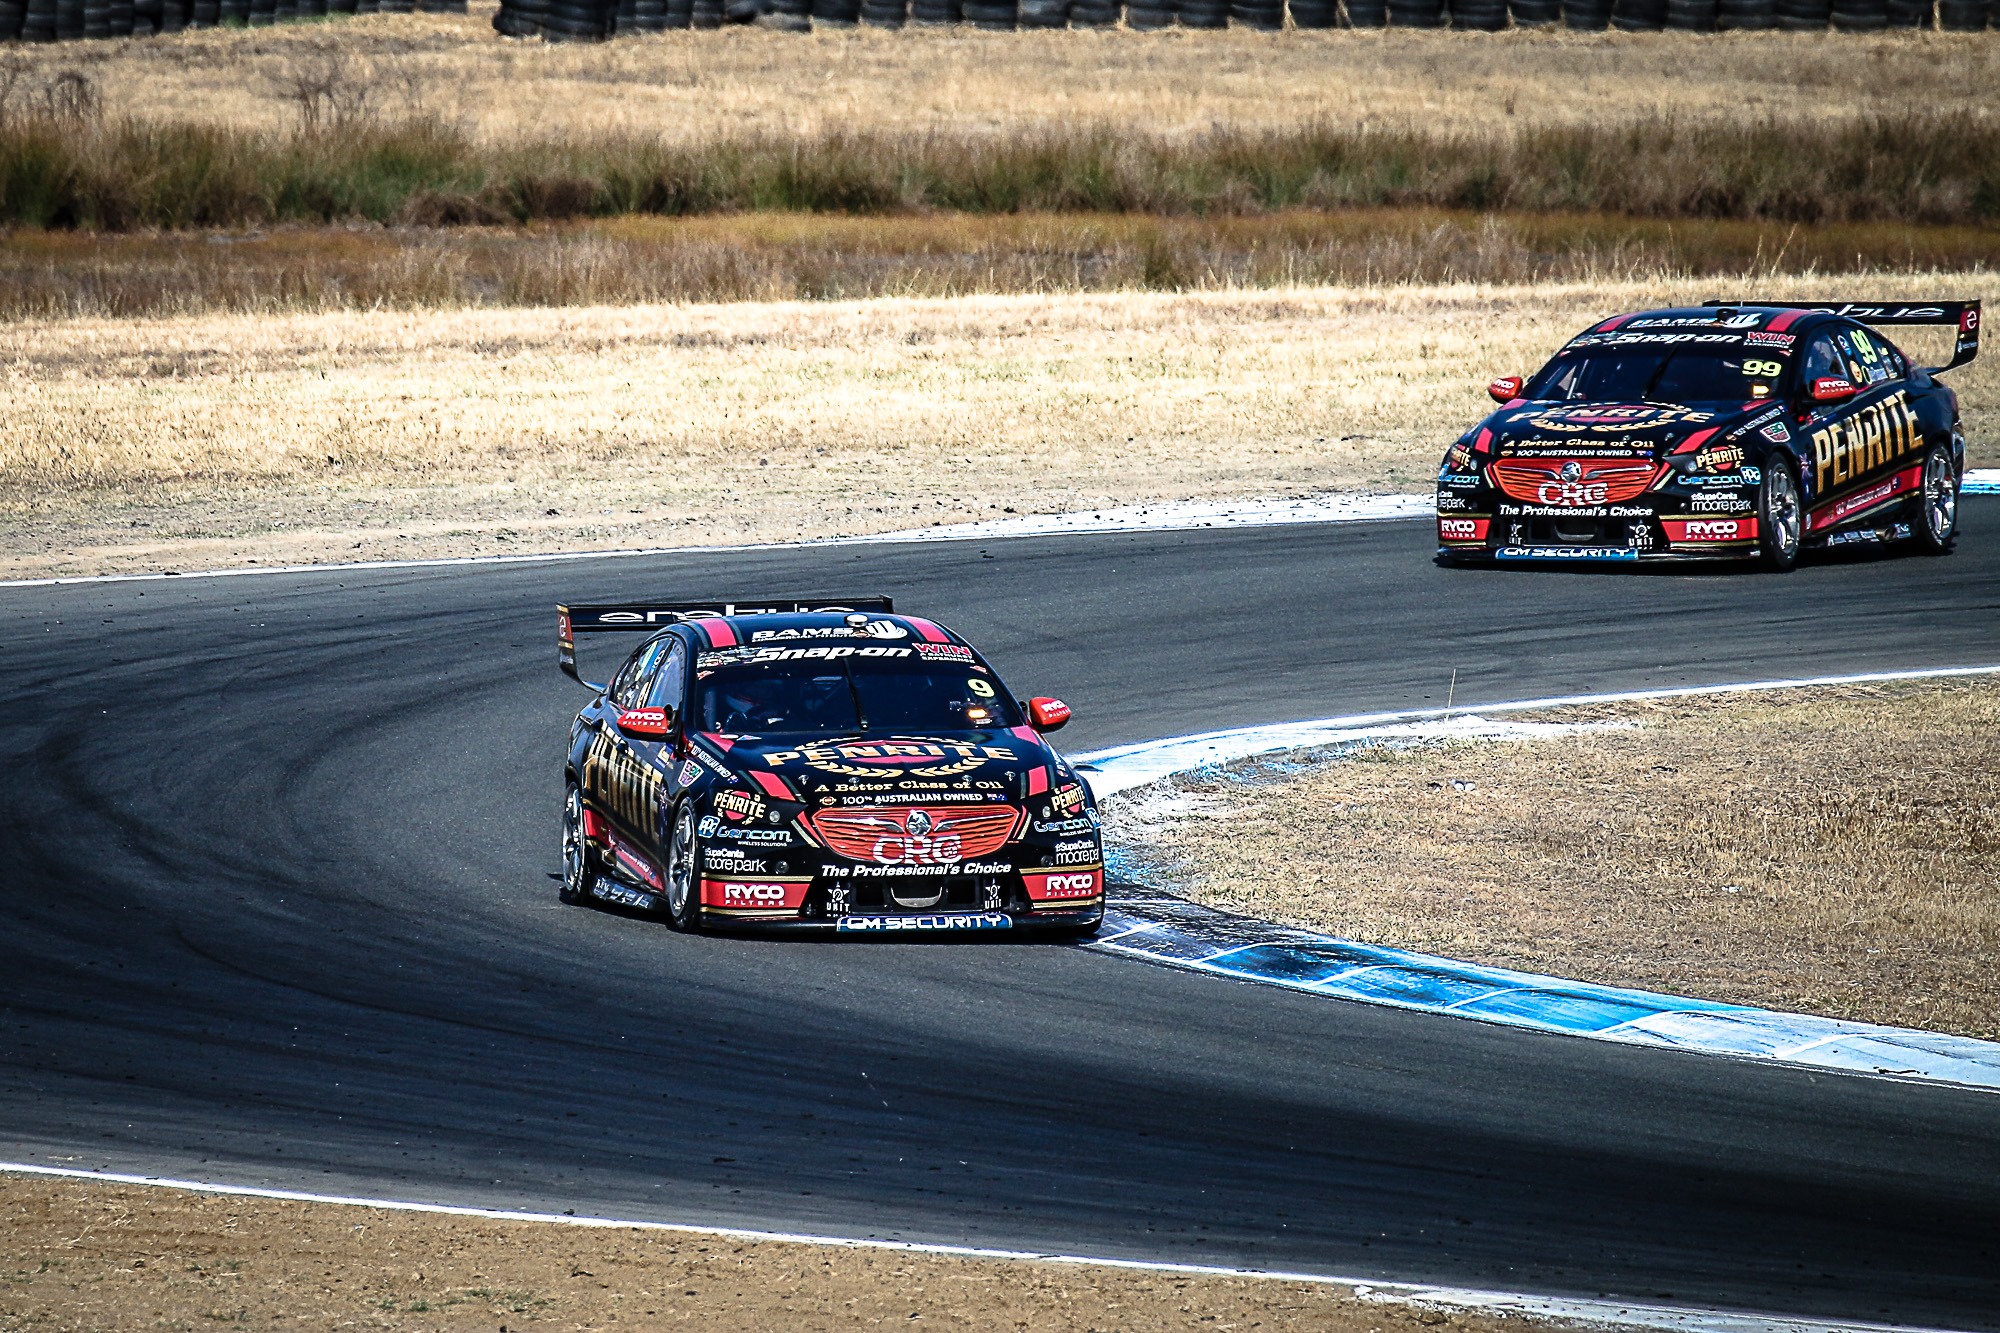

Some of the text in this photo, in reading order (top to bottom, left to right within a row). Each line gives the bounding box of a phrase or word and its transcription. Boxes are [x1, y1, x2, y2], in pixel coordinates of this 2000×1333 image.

[1609, 333, 1742, 345] Snap-on
[1748, 331, 1796, 345] WIN
[1741, 360, 1782, 377] 99
[1819, 381, 1850, 389] RYCO
[1506, 407, 1715, 423] PENRITE
[1631, 440, 1655, 448] Oil
[1812, 389, 1924, 495] PENRITE
[1540, 449, 1595, 457] AUSTRALIAN
[1596, 449, 1633, 457] OWNED
[1696, 448, 1745, 468] PENRITE
[1500, 504, 1654, 517] The Professional's Choice
[1441, 520, 1476, 532] RYCO
[1686, 521, 1738, 535] RYCO
[1531, 547, 1630, 557] SECURITY
[752, 627, 854, 640] BAMS
[745, 646, 913, 664] Snap-on
[912, 643, 973, 657] WIN
[967, 678, 995, 698] 9
[625, 711, 665, 721] RYCO
[762, 743, 1019, 767] PENRITE
[814, 784, 830, 792] A
[835, 783, 894, 792] Better
[898, 780, 949, 790] Class
[976, 781, 1004, 789] Oil
[713, 792, 767, 819] PENRITE
[875, 793, 942, 804] AUSTRALIAN
[943, 793, 983, 802] OWNED
[1051, 785, 1086, 812] PENRITE
[717, 825, 793, 843] Gencom
[872, 836, 964, 865] CRC
[821, 862, 1012, 877] The Professional's Choice
[1046, 874, 1093, 891] RYCO
[724, 884, 785, 900] RYCO
[1046, 888, 1093, 898] FILTERS
[826, 902, 850, 912] UNIT
[884, 914, 1004, 930] SECURITY
